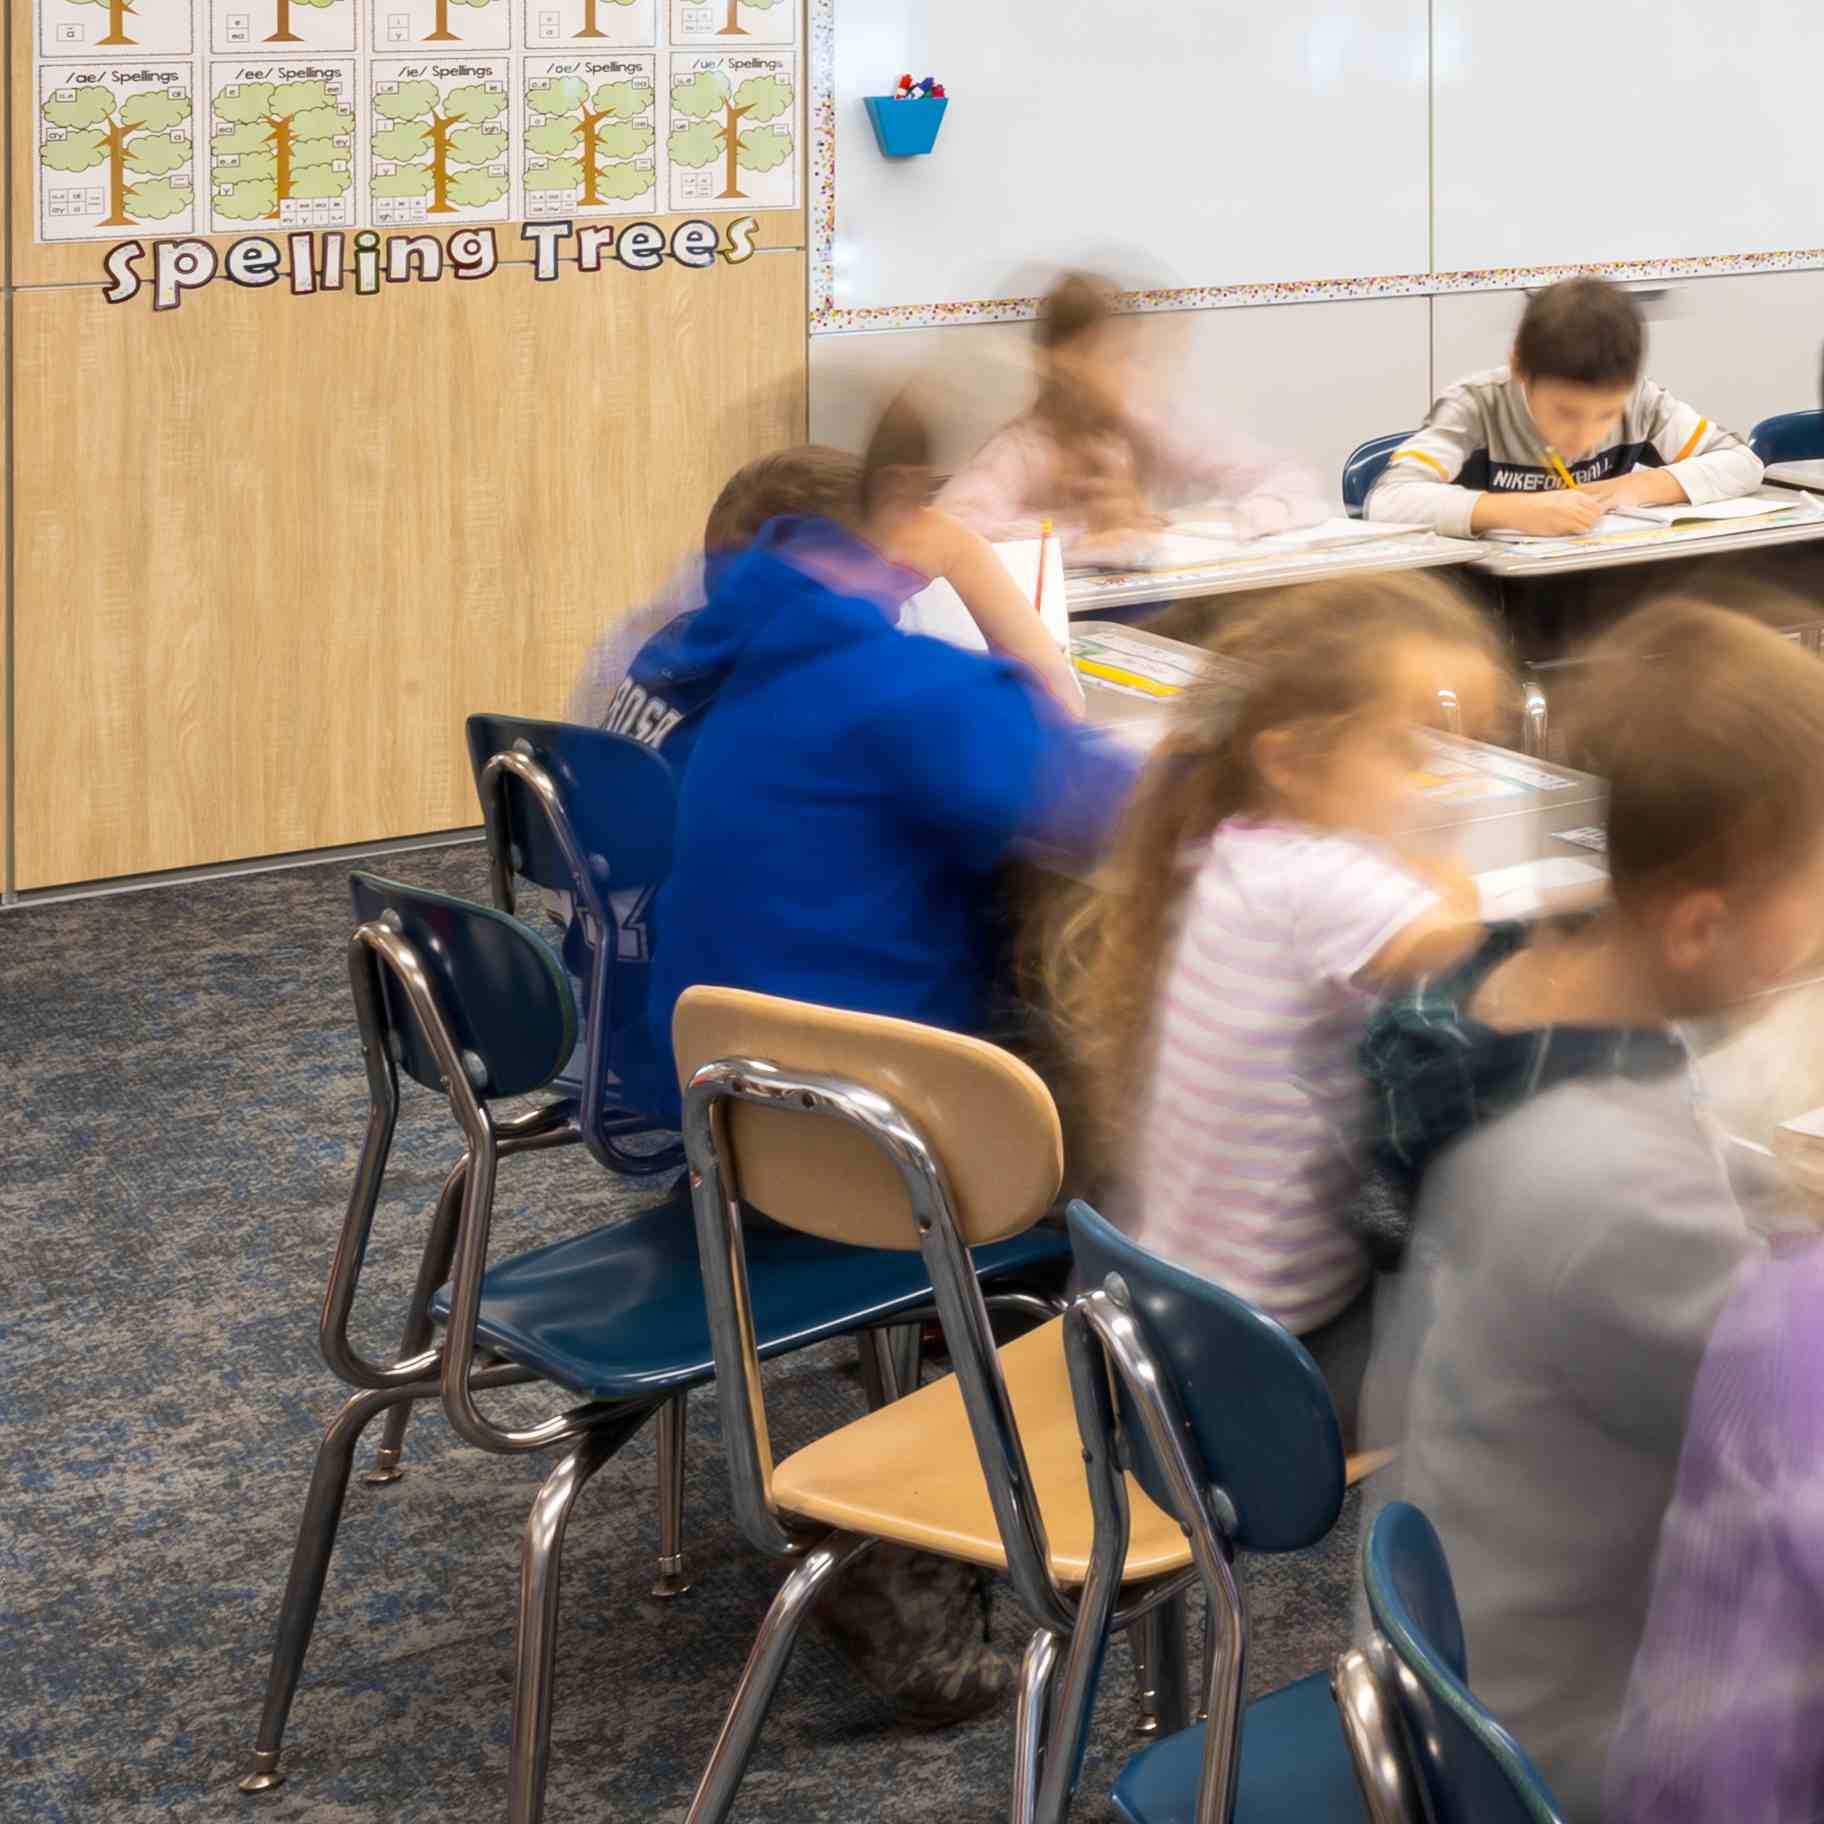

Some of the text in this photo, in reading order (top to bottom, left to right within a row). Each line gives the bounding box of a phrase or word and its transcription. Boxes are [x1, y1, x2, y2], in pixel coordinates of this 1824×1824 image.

[234, 67, 343, 84] /ee/ Spellings
[398, 64, 494, 79] /ie/ Spellings
[546, 60, 643, 75] /oe/ Spellings
[66, 70, 180, 86] /ae/ Spellings
[103, 216, 760, 311] Spelling Trees
